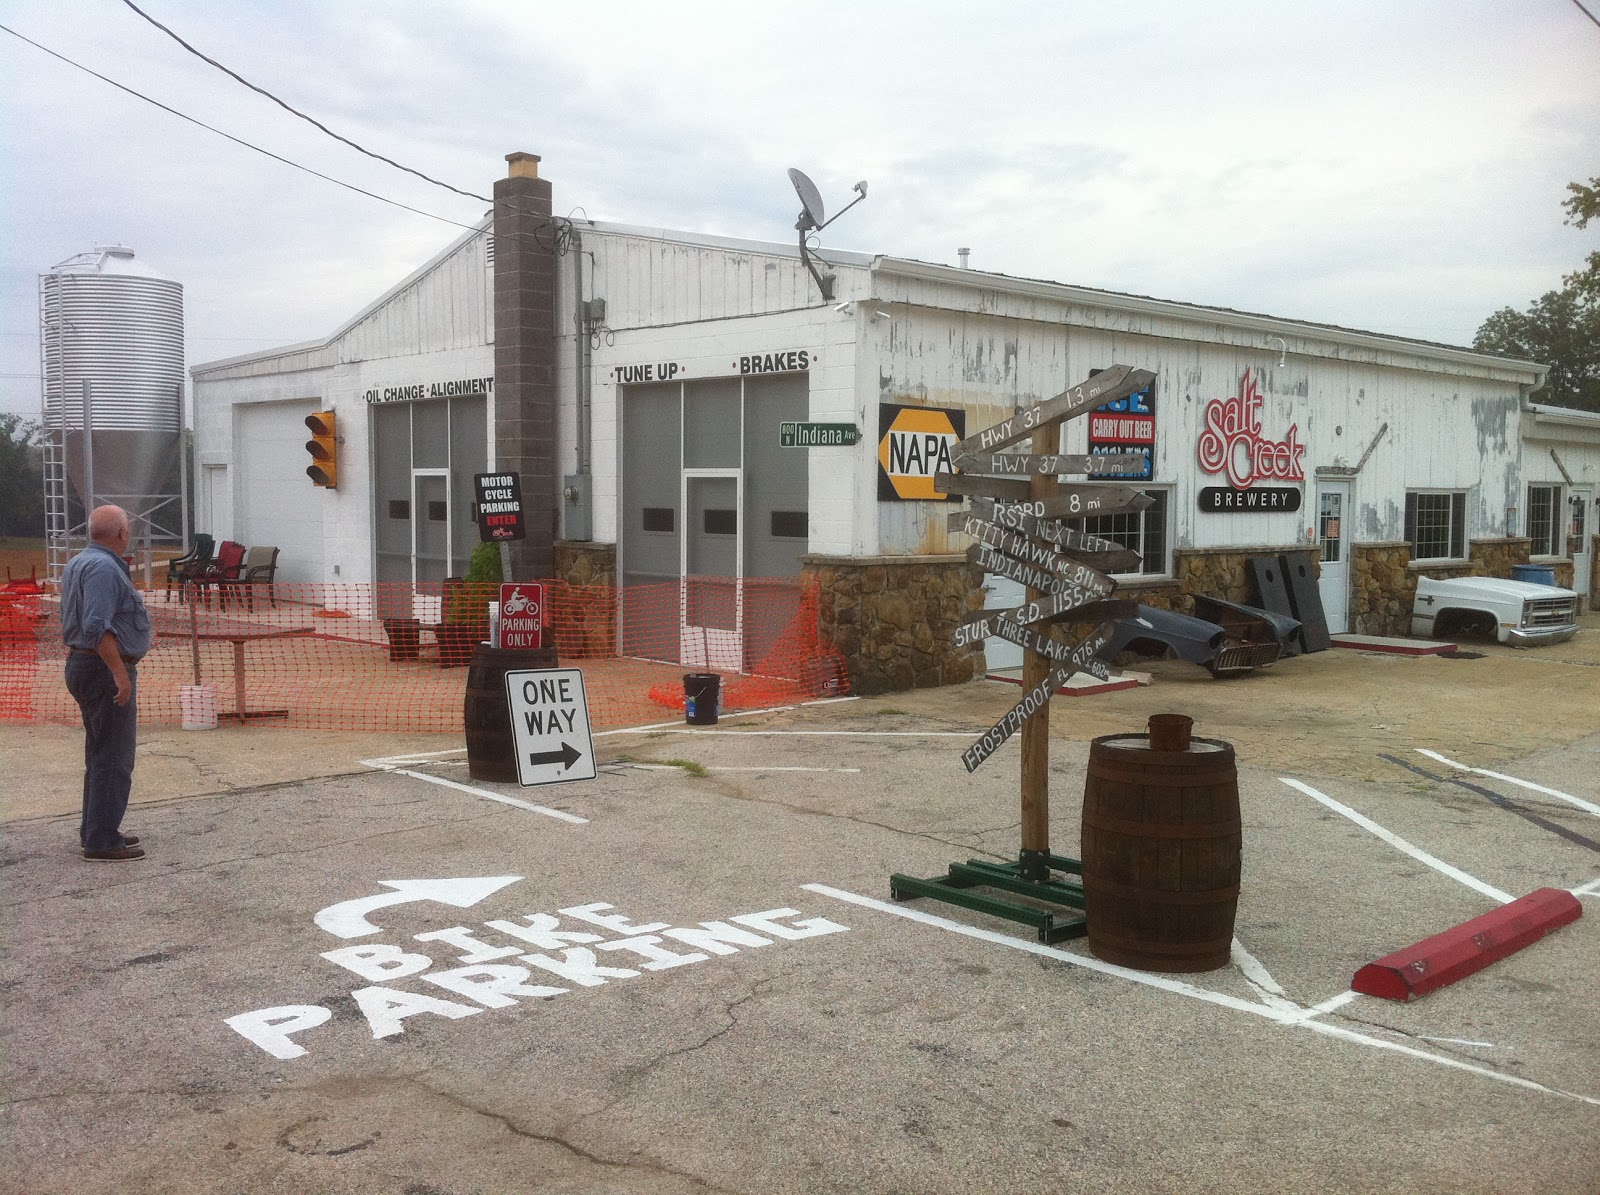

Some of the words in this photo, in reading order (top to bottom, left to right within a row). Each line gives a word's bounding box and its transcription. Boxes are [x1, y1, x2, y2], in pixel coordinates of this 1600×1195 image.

[615, 365, 653, 382] TUNE
[657, 362, 678, 380] UP
[740, 351, 809, 374] BRAKES
[366, 390, 382, 403] OIL
[384, 385, 425, 402] CHANGE
[430, 377, 494, 398] ALIGNMENT
[782, 424, 795, 435] 800
[981, 420, 1013, 449] HWY
[1024, 405, 1041, 428] 37
[1066, 387, 1084, 409] 1.3
[1092, 418, 1119, 438] CARRY
[1119, 419, 1134, 438] OUT
[1134, 420, 1152, 439] BEER
[1199, 373, 1262, 472] Salt
[785, 435, 791, 445] N
[798, 425, 842, 444] Indiana
[844, 430, 856, 440] Ave
[889, 432, 953, 475] NAPA
[991, 455, 1029, 473] HWY
[1038, 456, 1058, 474] 37
[1084, 456, 1106, 473] 3.7
[1111, 461, 1124, 473] mi
[1227, 424, 1303, 488] Creek
[481, 476, 514, 488] MOTOR
[484, 489, 513, 500] CYCLE
[1070, 494, 1081, 512] 8
[1087, 497, 1101, 509] mi
[1214, 492, 1288, 507] BREWERY
[480, 501, 520, 513] PARKING
[486, 514, 517, 526] ENTER
[1035, 519, 1074, 546] NEXT
[1080, 533, 1111, 552] LEFT
[964, 516, 1008, 548] KITTY
[1011, 535, 1057, 571] HAWK
[1074, 566, 1095, 588] 811
[1053, 587, 1082, 614] 1155
[502, 618, 540, 631] PARKING
[996, 616, 1032, 648] THREE
[507, 633, 533, 646] ONLY
[523, 679, 573, 705] ONE
[965, 678, 1050, 770] FROSTPROOF
[1056, 668, 1069, 682] FL
[1072, 641, 1093, 666] 976
[524, 708, 577, 736] WAY
[319, 902, 671, 982] BIKE
[223, 908, 852, 1060] PARKING
